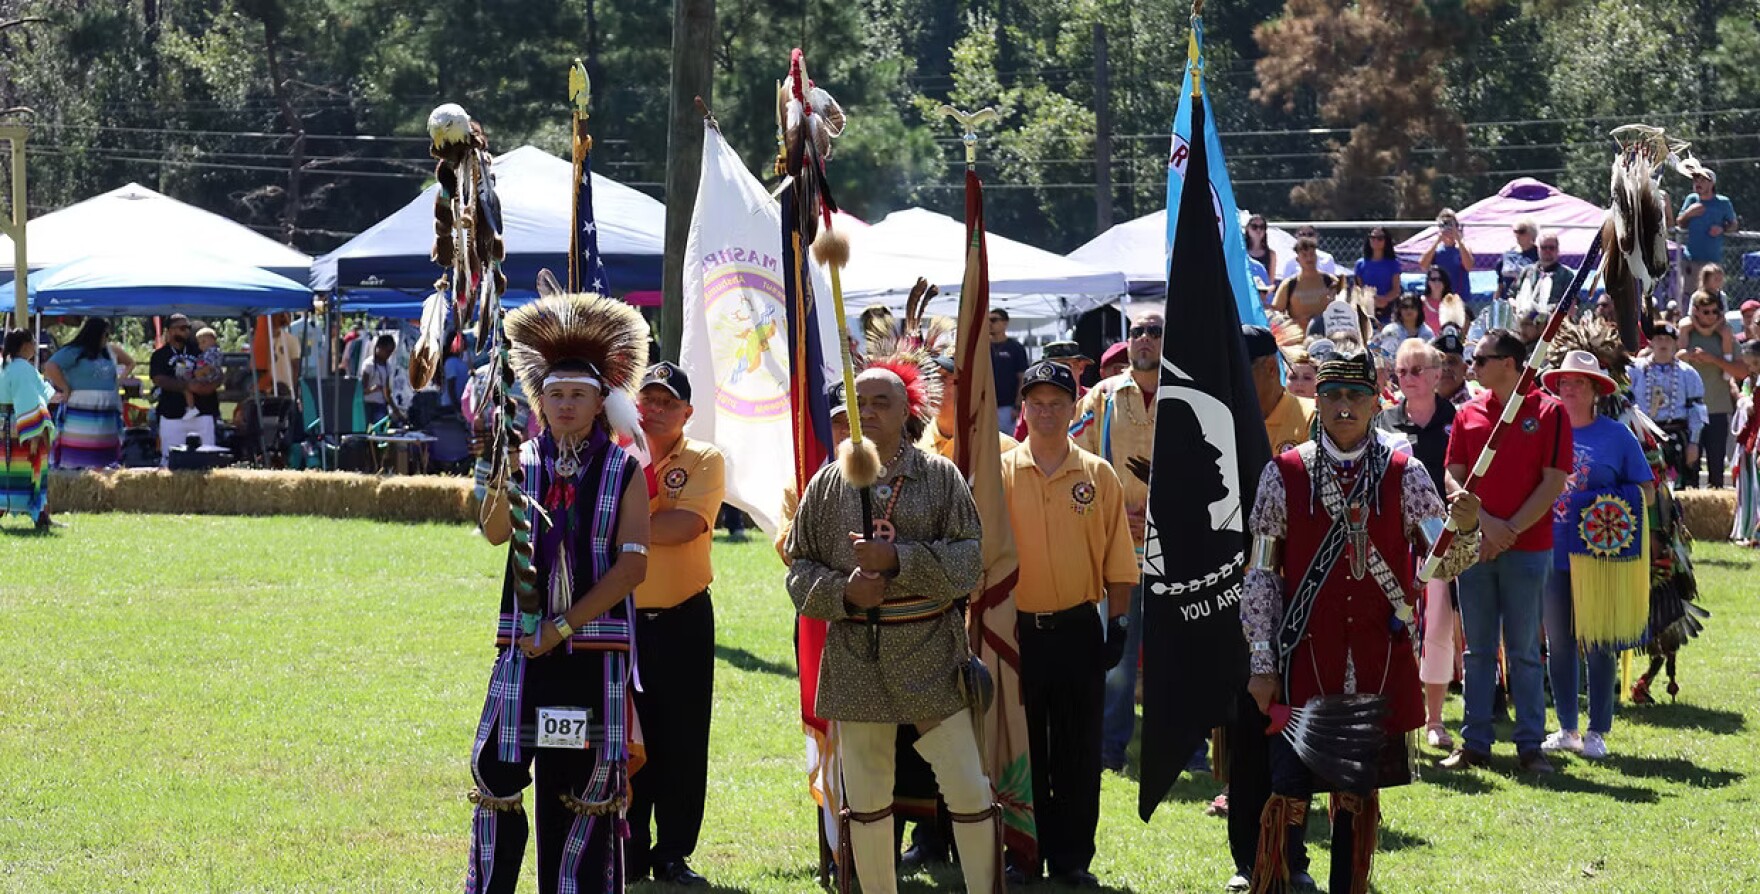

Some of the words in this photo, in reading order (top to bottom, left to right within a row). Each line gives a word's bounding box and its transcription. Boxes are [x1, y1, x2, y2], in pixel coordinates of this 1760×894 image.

[1180, 600, 1211, 621] YOU
[1216, 582, 1242, 611] ARE
[545, 718, 586, 735] 087
